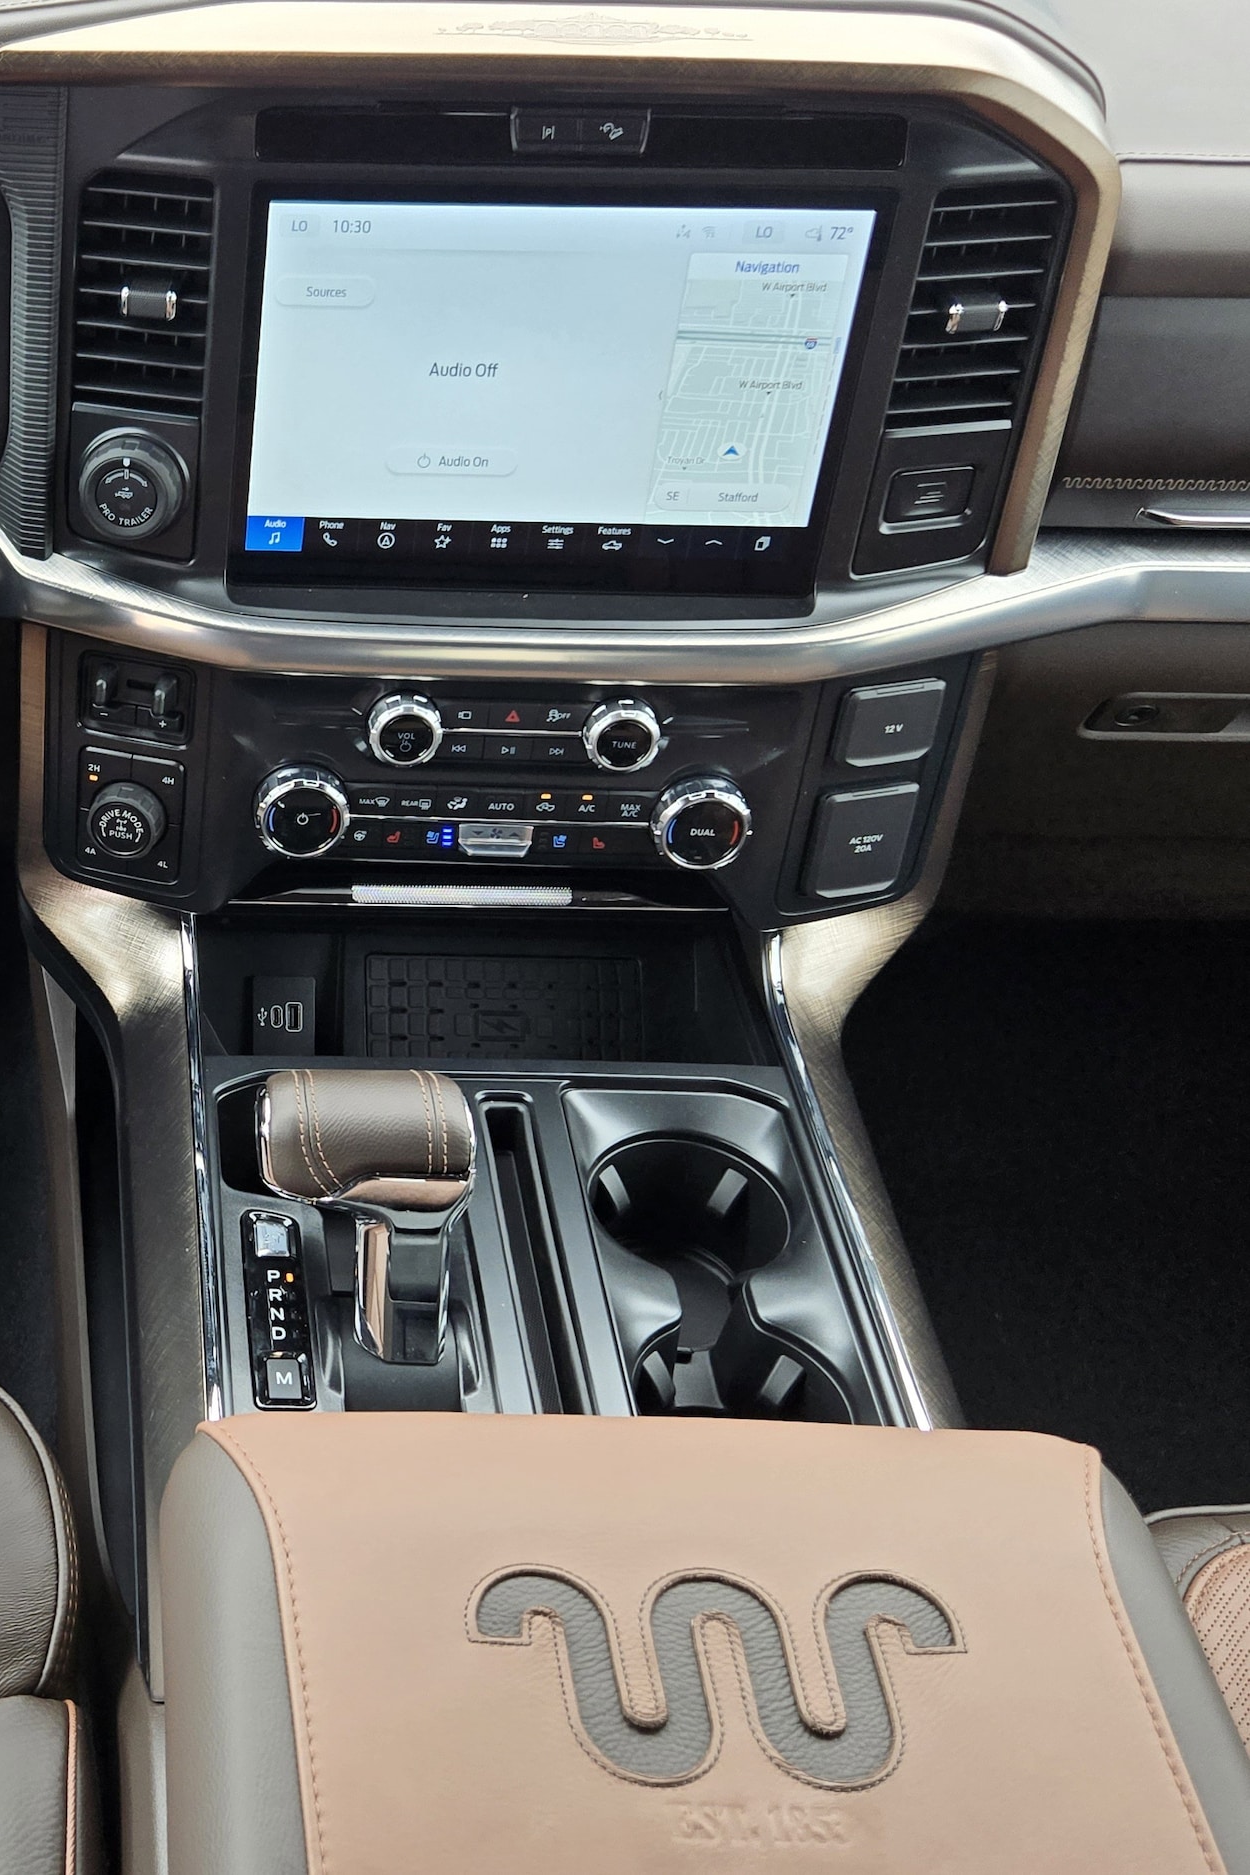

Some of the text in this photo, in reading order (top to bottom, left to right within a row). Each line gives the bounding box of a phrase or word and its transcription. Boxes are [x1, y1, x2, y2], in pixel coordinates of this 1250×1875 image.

[291, 220, 308, 233] LO
[332, 219, 372, 234] 10:30
[755, 226, 773, 239] LO
[830, 226, 854, 240] 72°
[735, 261, 800, 275] Navigation
[306, 286, 347, 299] Sources
[762, 282, 828, 293] W Airport Blvd
[429, 362, 499, 378] Audio Off
[740, 380, 803, 391] W Airport Blvd
[438, 455, 489, 468] Audio On
[666, 491, 680, 501] SE
[718, 491, 759, 503] Stafford
[99, 503, 154, 527] PRO TRAILER
[264, 519, 287, 529] Audio
[319, 520, 345, 531] Phone
[380, 521, 396, 531] Nav
[437, 522, 452, 532] Fav
[490, 523, 511, 535] Apps
[541, 524, 574, 536] Settings
[598, 525, 631, 536] Features
[397, 732, 416, 741] VOL
[612, 740, 637, 750] TUNE
[88, 763, 101, 772] 2H
[161, 776, 174, 786] 4H
[488, 802, 515, 811] AUTO
[578, 804, 596, 812] A/C
[620, 803, 642, 811] MAX
[621, 810, 639, 818] A/C
[99, 808, 144, 834] DRIVE MODE
[109, 829, 133, 840] PUSH
[689, 827, 716, 837] DUAL
[849, 833, 884, 845] AC 120V
[84, 846, 96, 855] 4A
[854, 844, 872, 853] 20A
[157, 860, 168, 869] 4L
[266, 1269, 281, 1282] P
[268, 1288, 283, 1302] R
[270, 1307, 285, 1321] N
[271, 1326, 287, 1340] D
[275, 1371, 293, 1385] M
